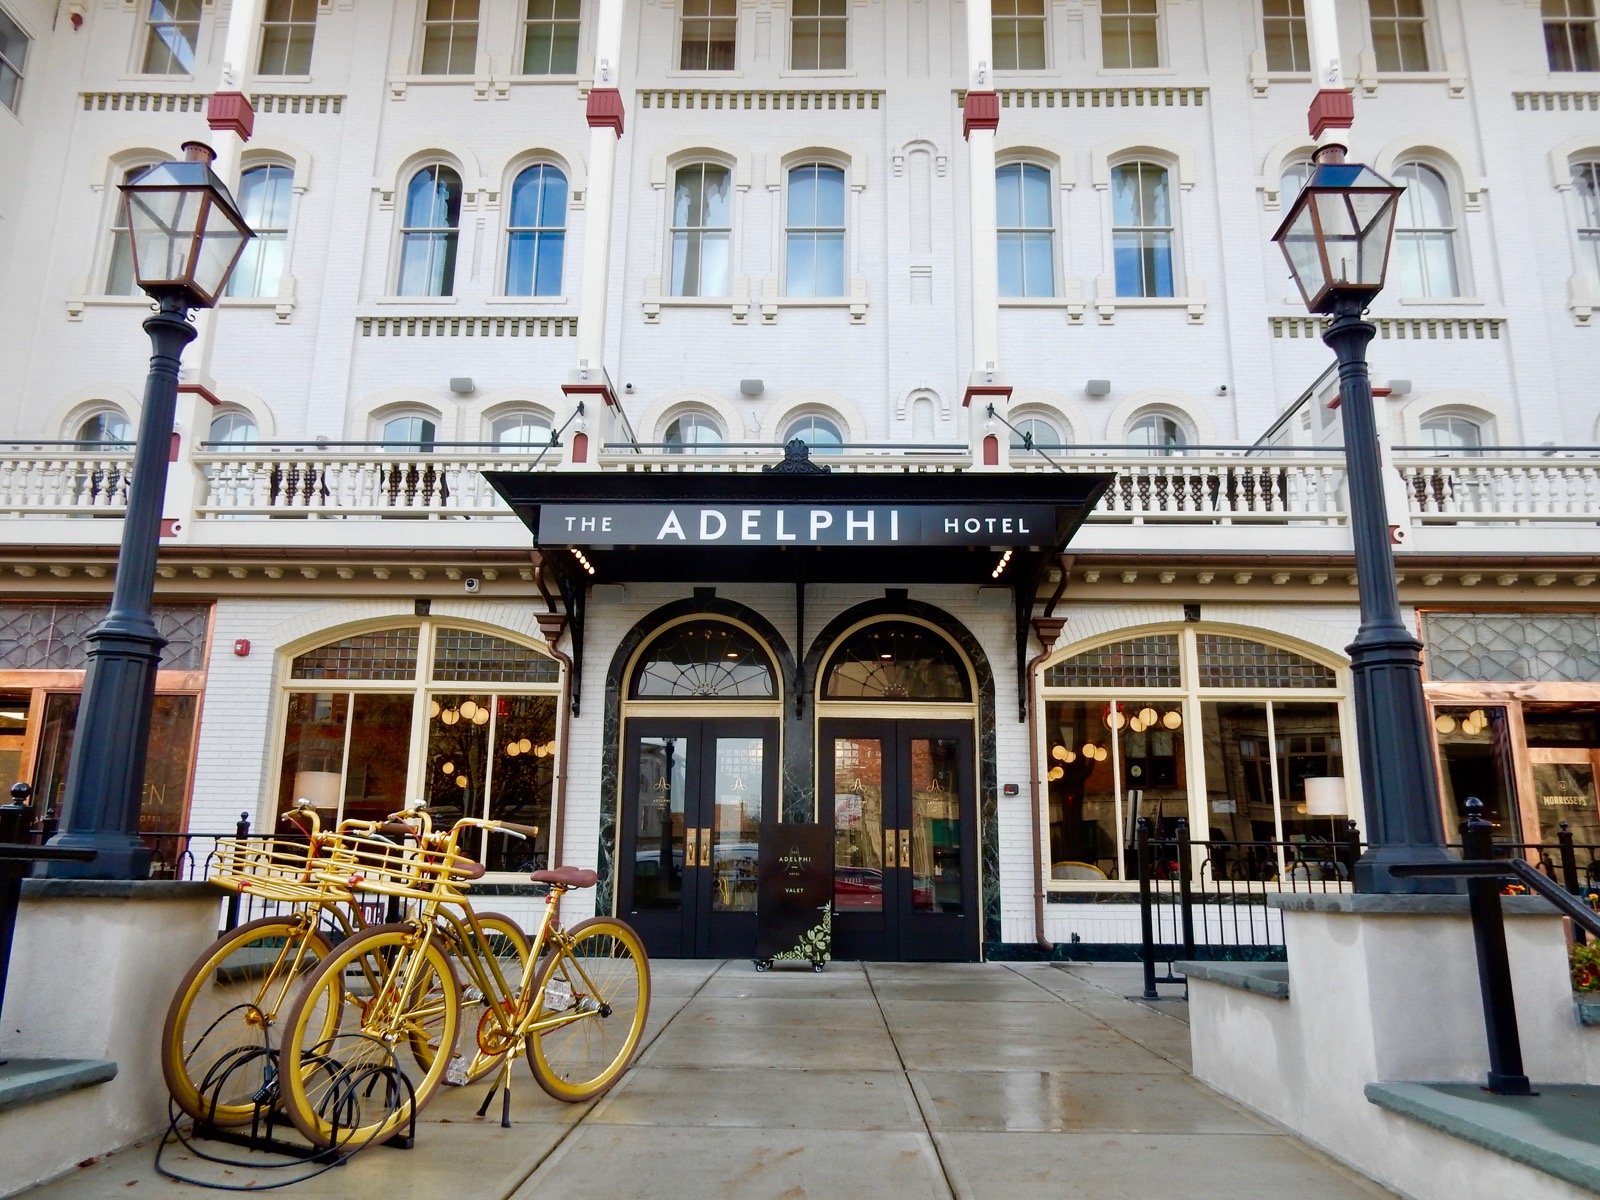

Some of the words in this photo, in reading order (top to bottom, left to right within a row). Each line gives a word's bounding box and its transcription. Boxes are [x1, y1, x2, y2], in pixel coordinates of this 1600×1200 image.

[564, 516, 613, 532] THE
[655, 509, 899, 541] ADELPHI
[943, 517, 1030, 534] HOTEL
